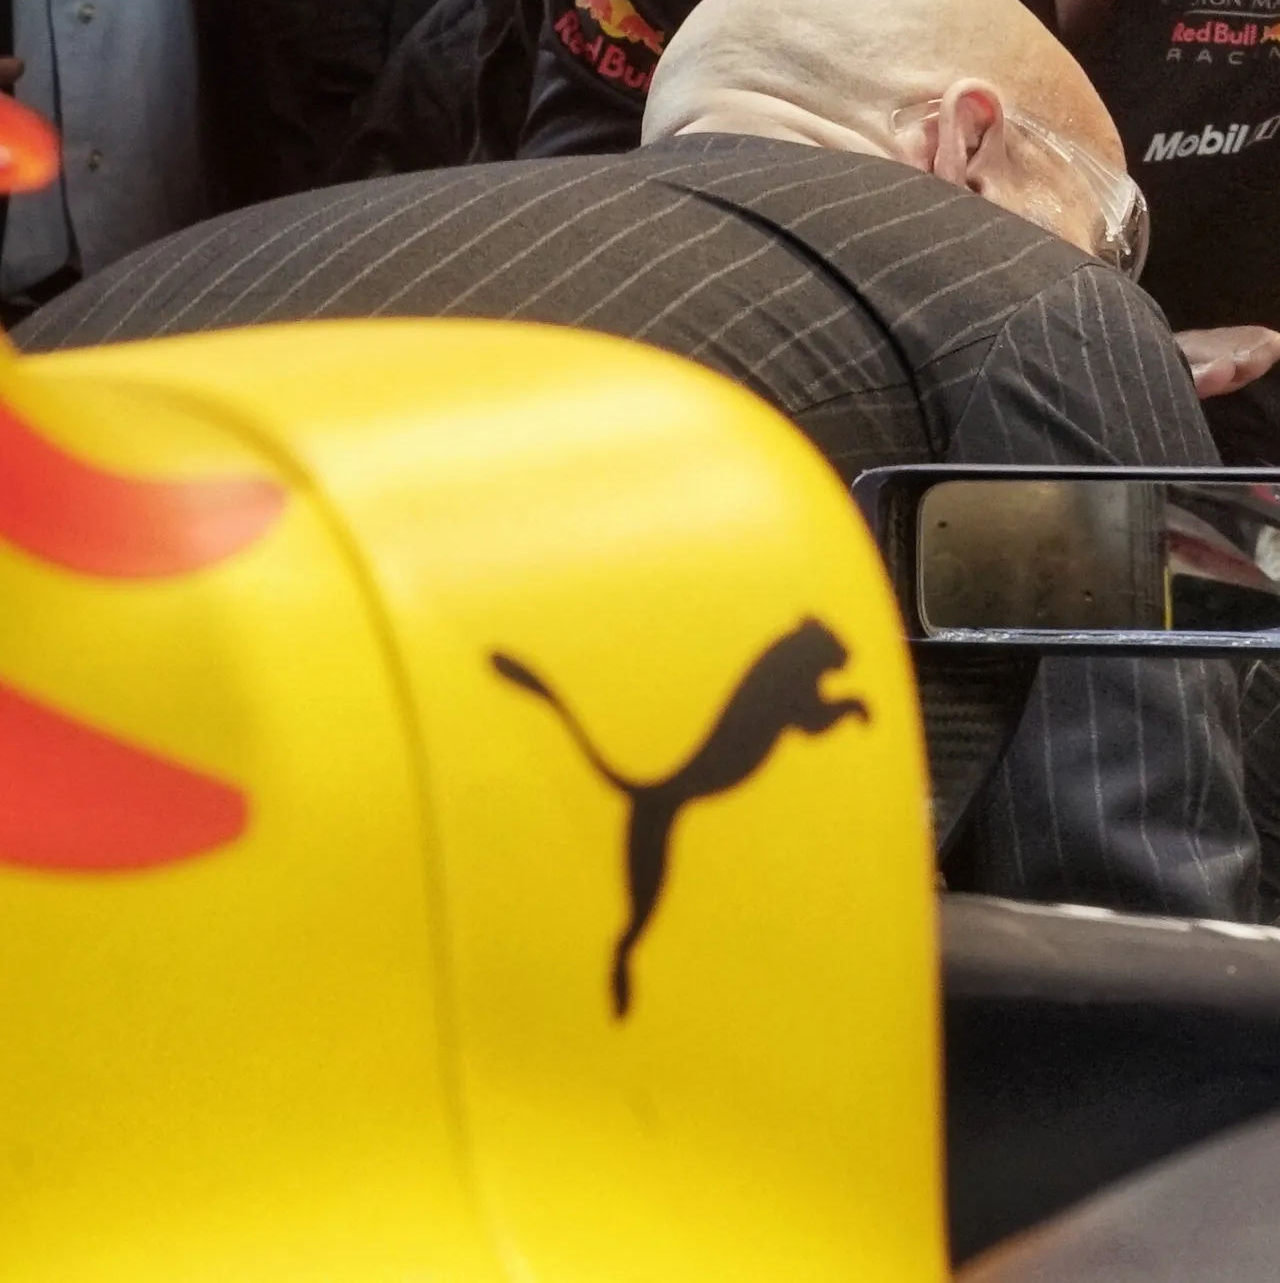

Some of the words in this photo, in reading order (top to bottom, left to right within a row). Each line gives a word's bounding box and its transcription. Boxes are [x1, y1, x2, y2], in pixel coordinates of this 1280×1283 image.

[553, 9, 604, 63] Red
[1171, 20, 1213, 44] Red
[1213, 20, 1259, 46] Bull
[1142, 122, 1251, 163] Mobil
